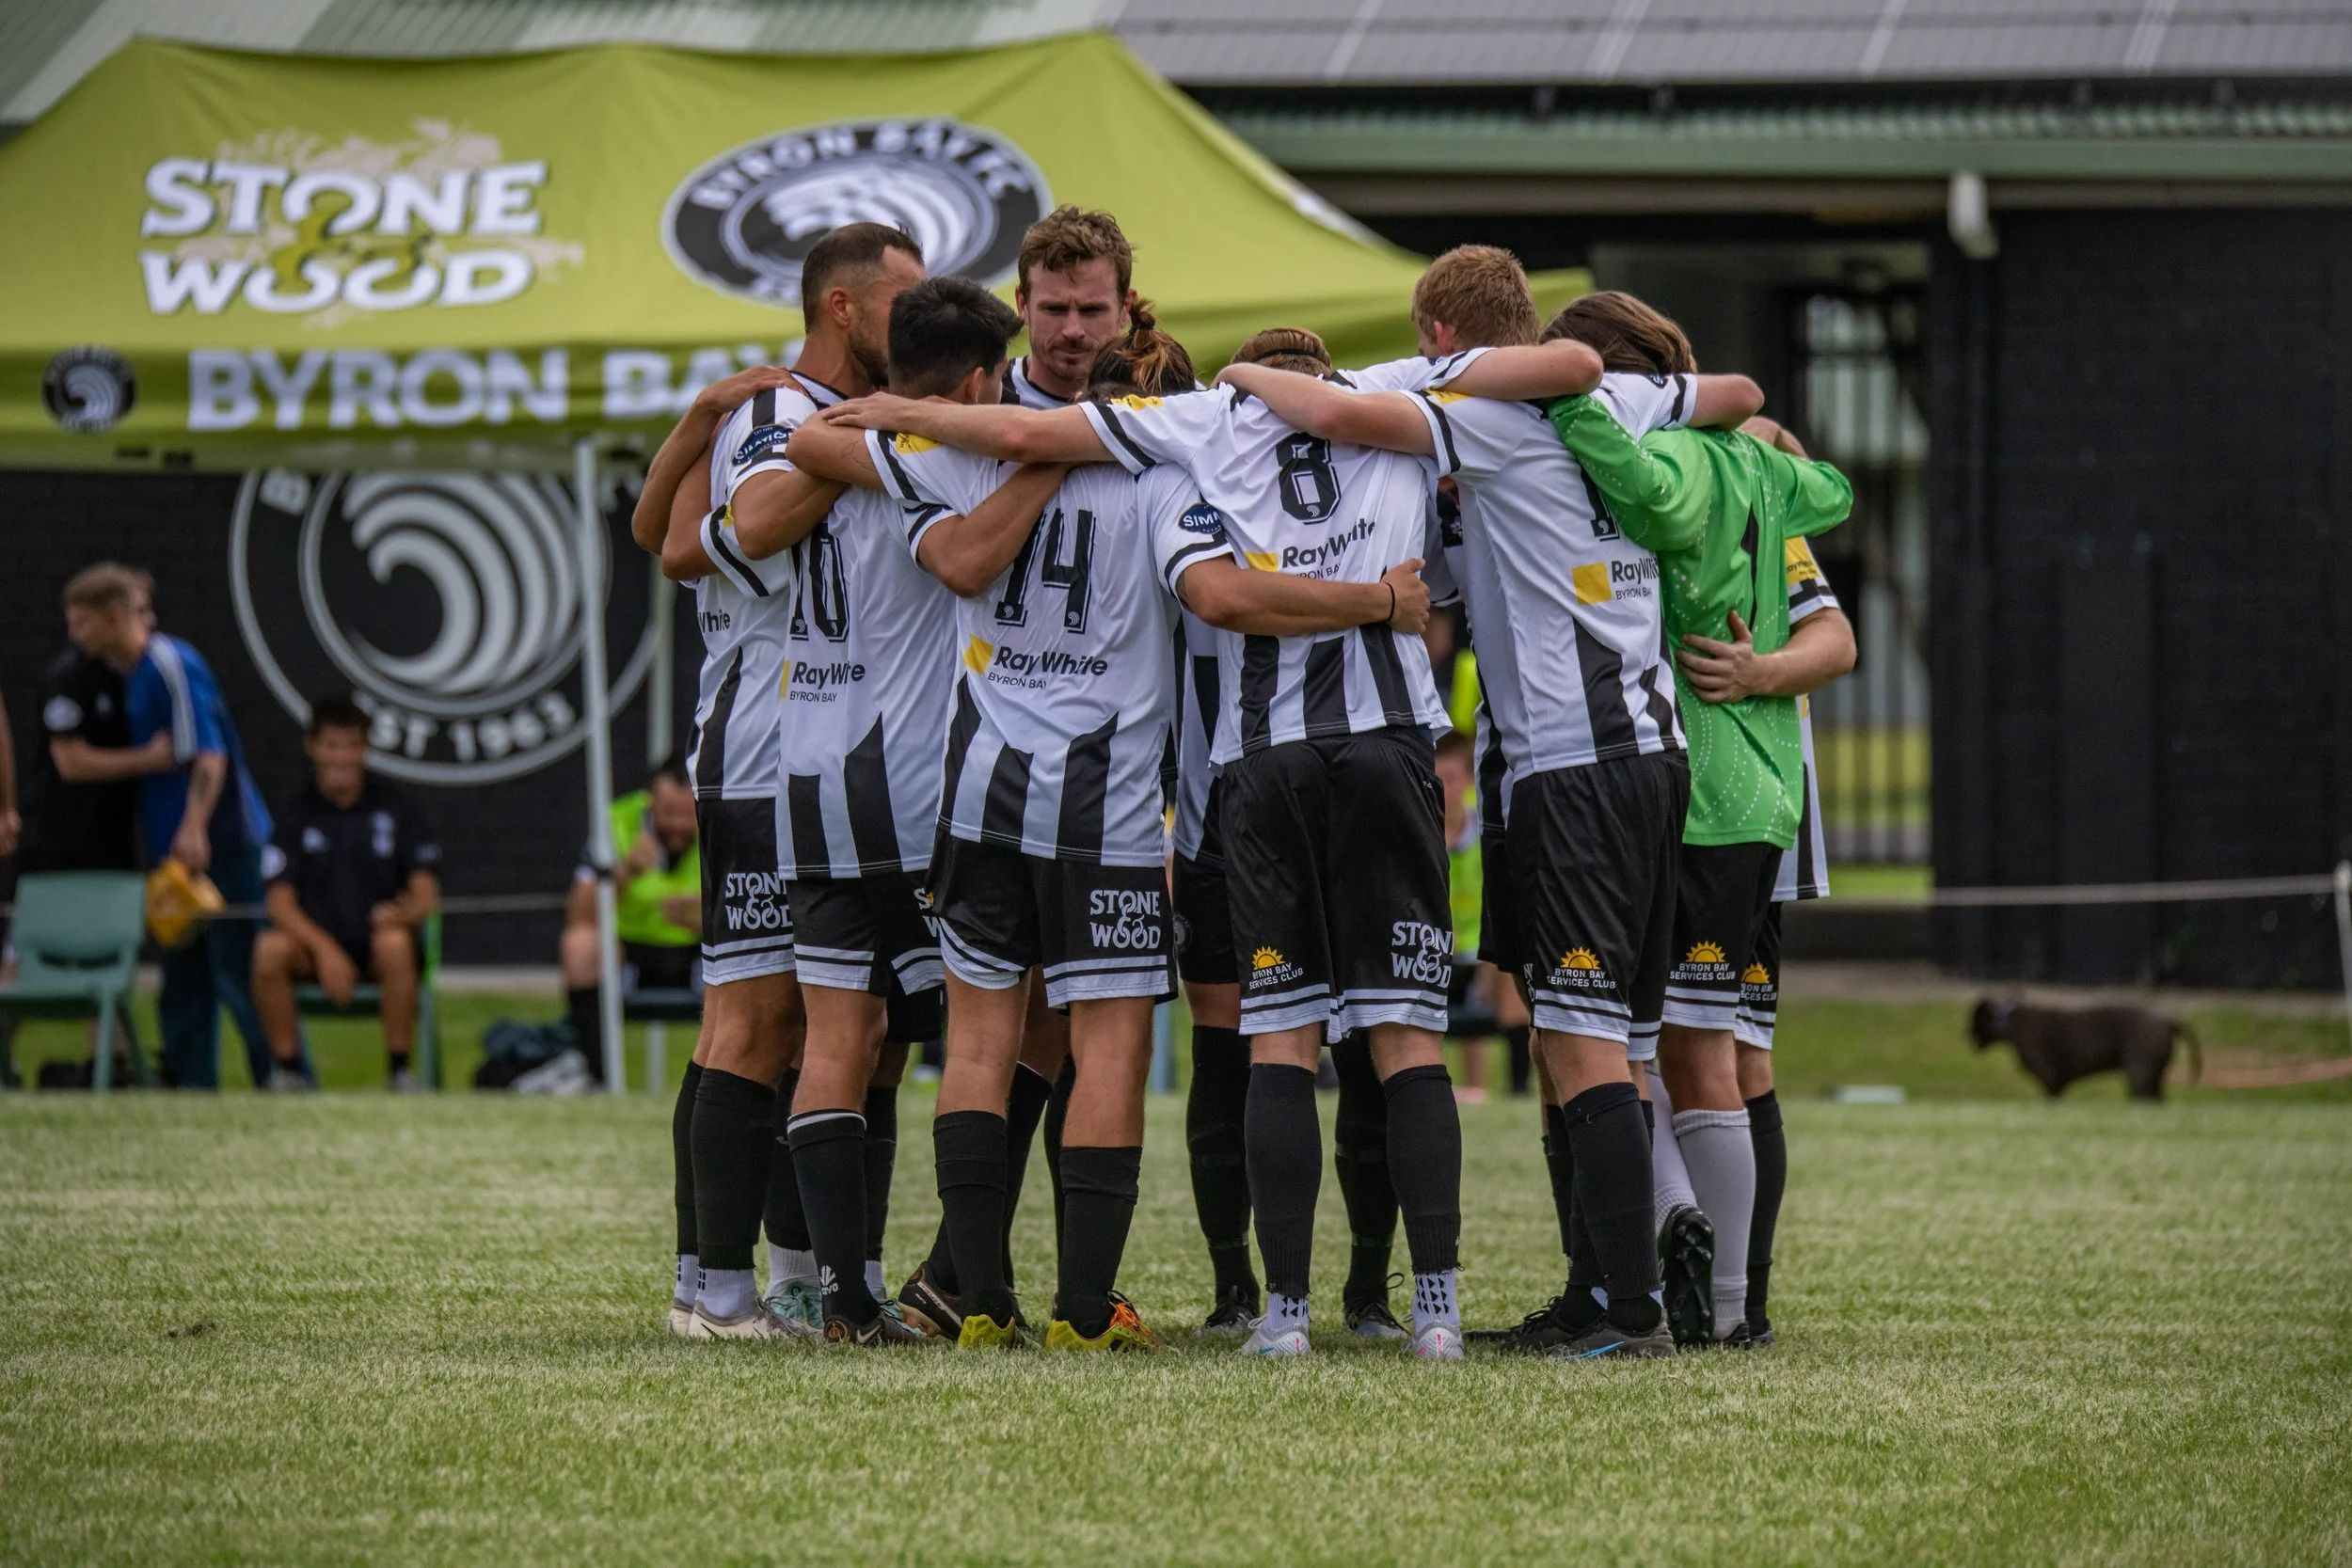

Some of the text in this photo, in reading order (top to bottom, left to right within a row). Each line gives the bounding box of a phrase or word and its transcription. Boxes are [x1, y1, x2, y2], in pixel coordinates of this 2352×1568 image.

[141, 158, 547, 237] STONE
[139, 249, 533, 313] WOOD
[189, 348, 568, 431] BYRON
[1276, 432, 1342, 525] 8
[994, 508, 1096, 634] 14
[1327, 563, 1341, 576] BA
[993, 646, 1108, 675] RayWhite
[988, 672, 1026, 688] BYRON
[790, 691, 837, 703] BYRON BAY
[1089, 889, 1161, 917] STONE
[1089, 922, 1162, 949] WOOD
[1391, 921, 1454, 956] STON
[1249, 967, 1304, 990] SERVICES CLUB
[1275, 961, 1292, 974] BAY
[1391, 952, 1453, 989] WOOD
[1555, 968, 1606, 979] BYRON BAY
[1670, 971, 1736, 980] SERVICES CLUB
[1679, 962, 1730, 972] BYRON BAY
[1593, 979, 1616, 990] CLUB
